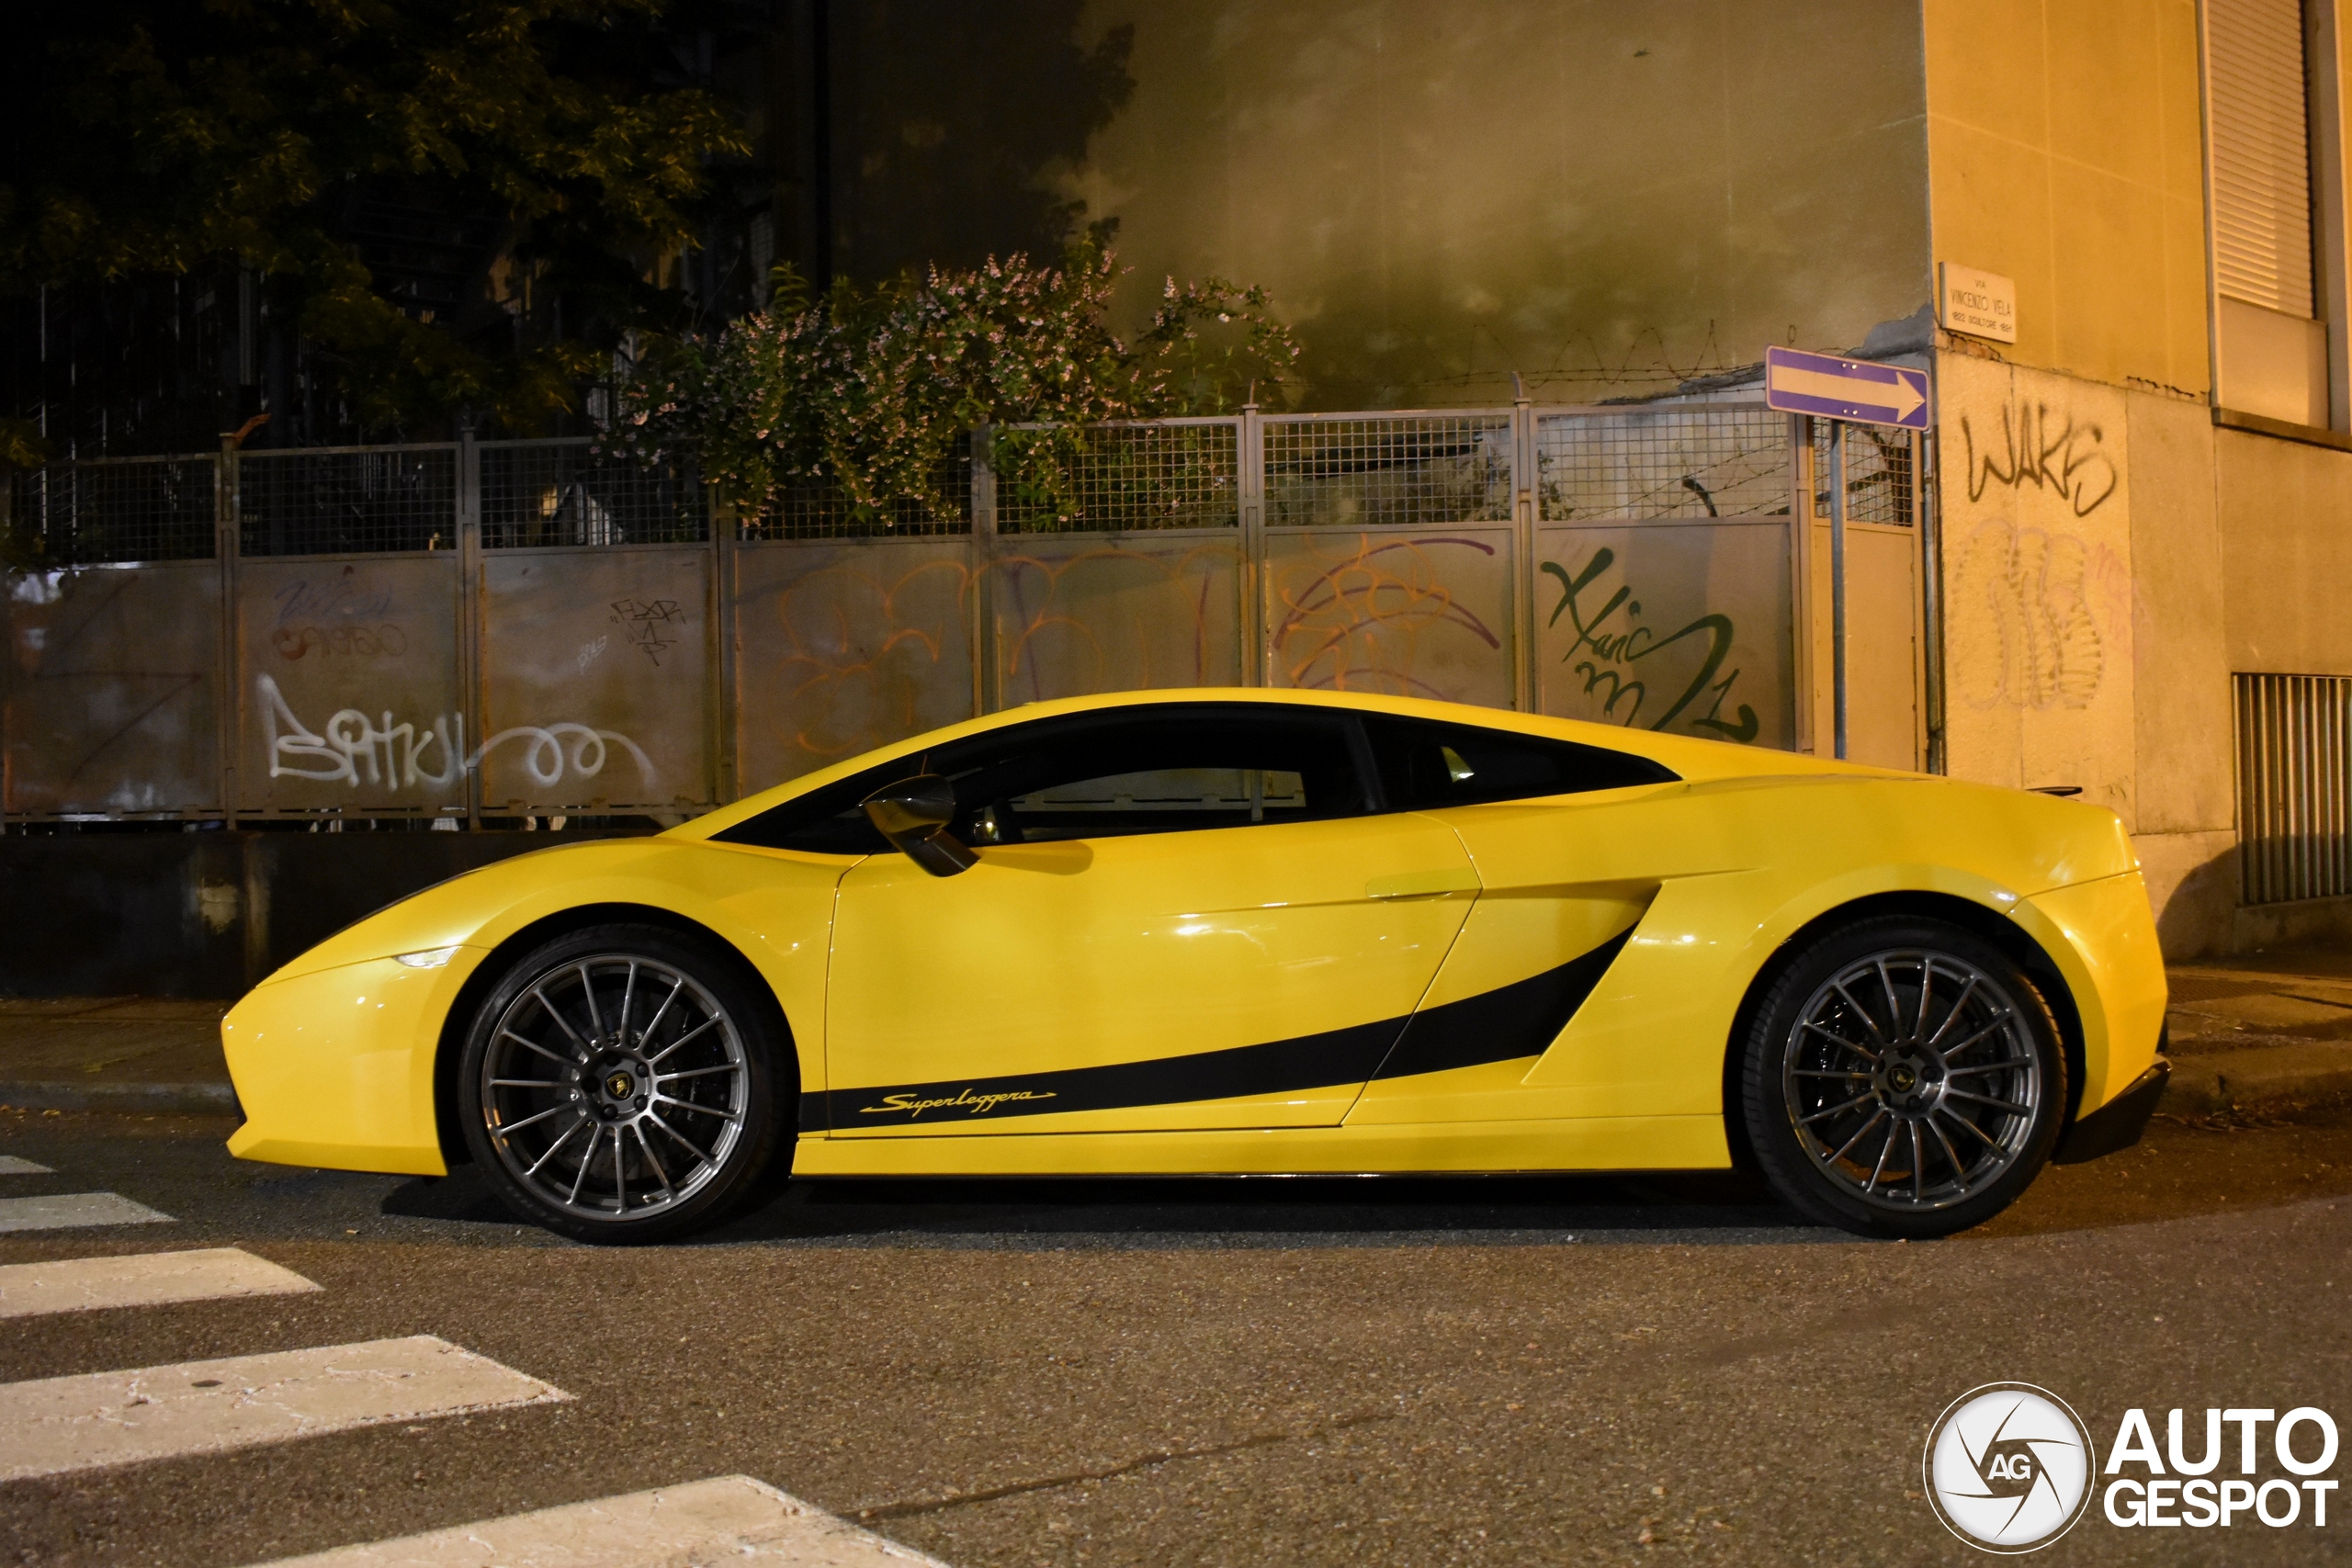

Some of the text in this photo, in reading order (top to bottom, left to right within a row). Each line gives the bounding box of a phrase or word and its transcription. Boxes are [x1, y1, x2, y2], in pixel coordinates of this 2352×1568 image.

[1975, 279, 1985, 288] VIA
[1951, 289, 2010, 316] VINCENZO VELA
[859, 1088, 1057, 1118] Superleggera
